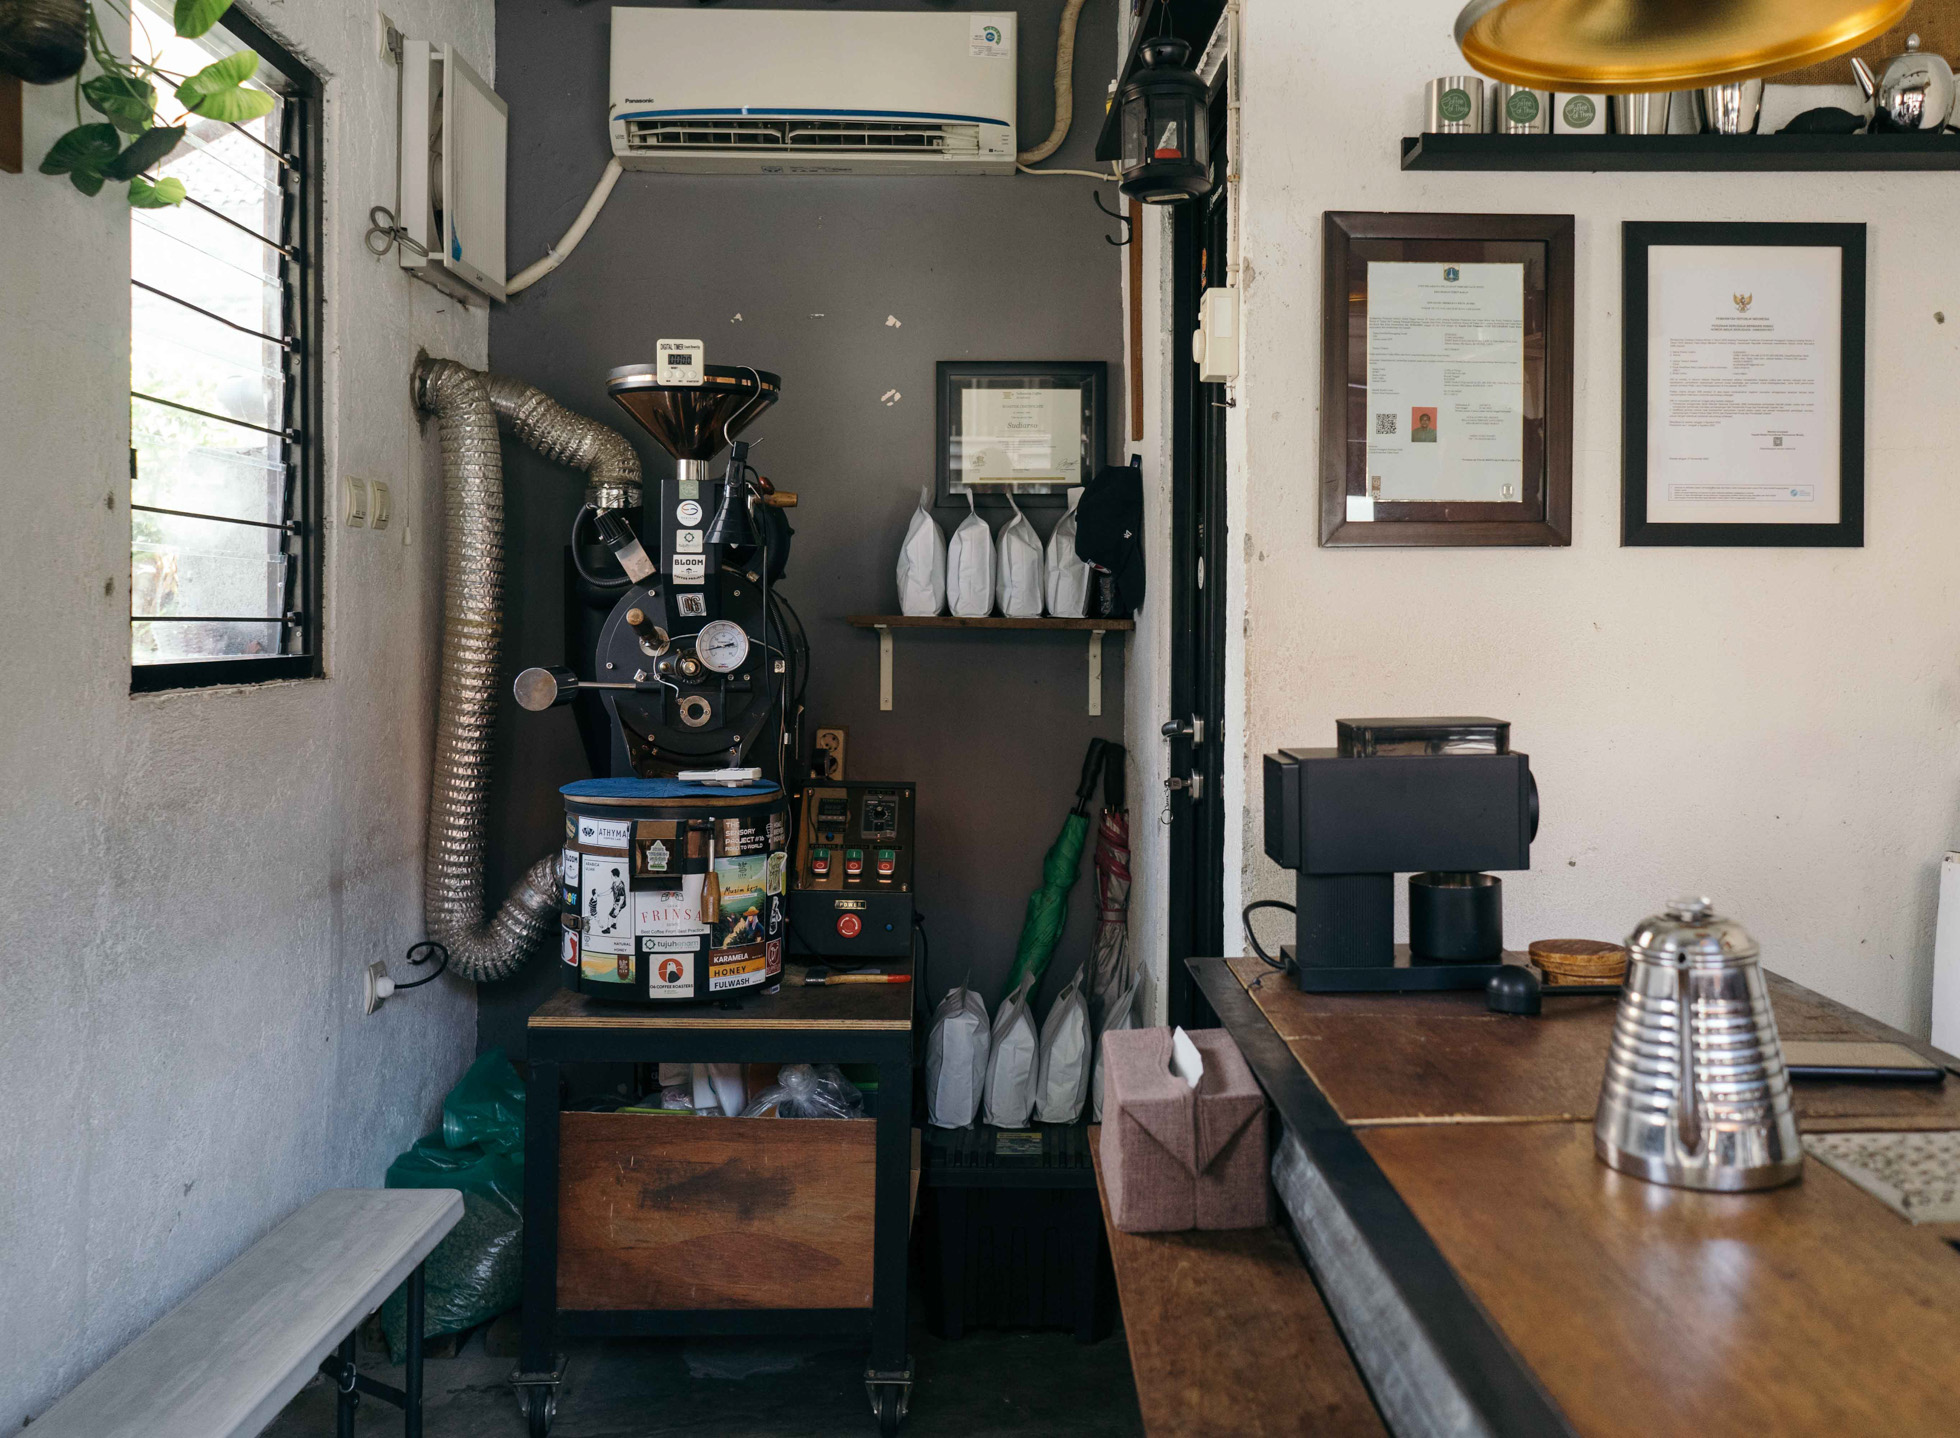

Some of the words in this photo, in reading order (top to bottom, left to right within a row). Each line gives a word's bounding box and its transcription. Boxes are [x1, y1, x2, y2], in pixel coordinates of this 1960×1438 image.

[599, 828, 627, 838] ATHYMA
[726, 828, 756, 836] SENSORY
[725, 836, 754, 844] PROJECT
[724, 886, 744, 895] Musim
[642, 909, 702, 923] FRINSA
[658, 940, 699, 949] tujuhenam
[714, 953, 748, 963] KARAMELA
[714, 966, 746, 977] HONEY
[714, 978, 750, 989] FULWASH
